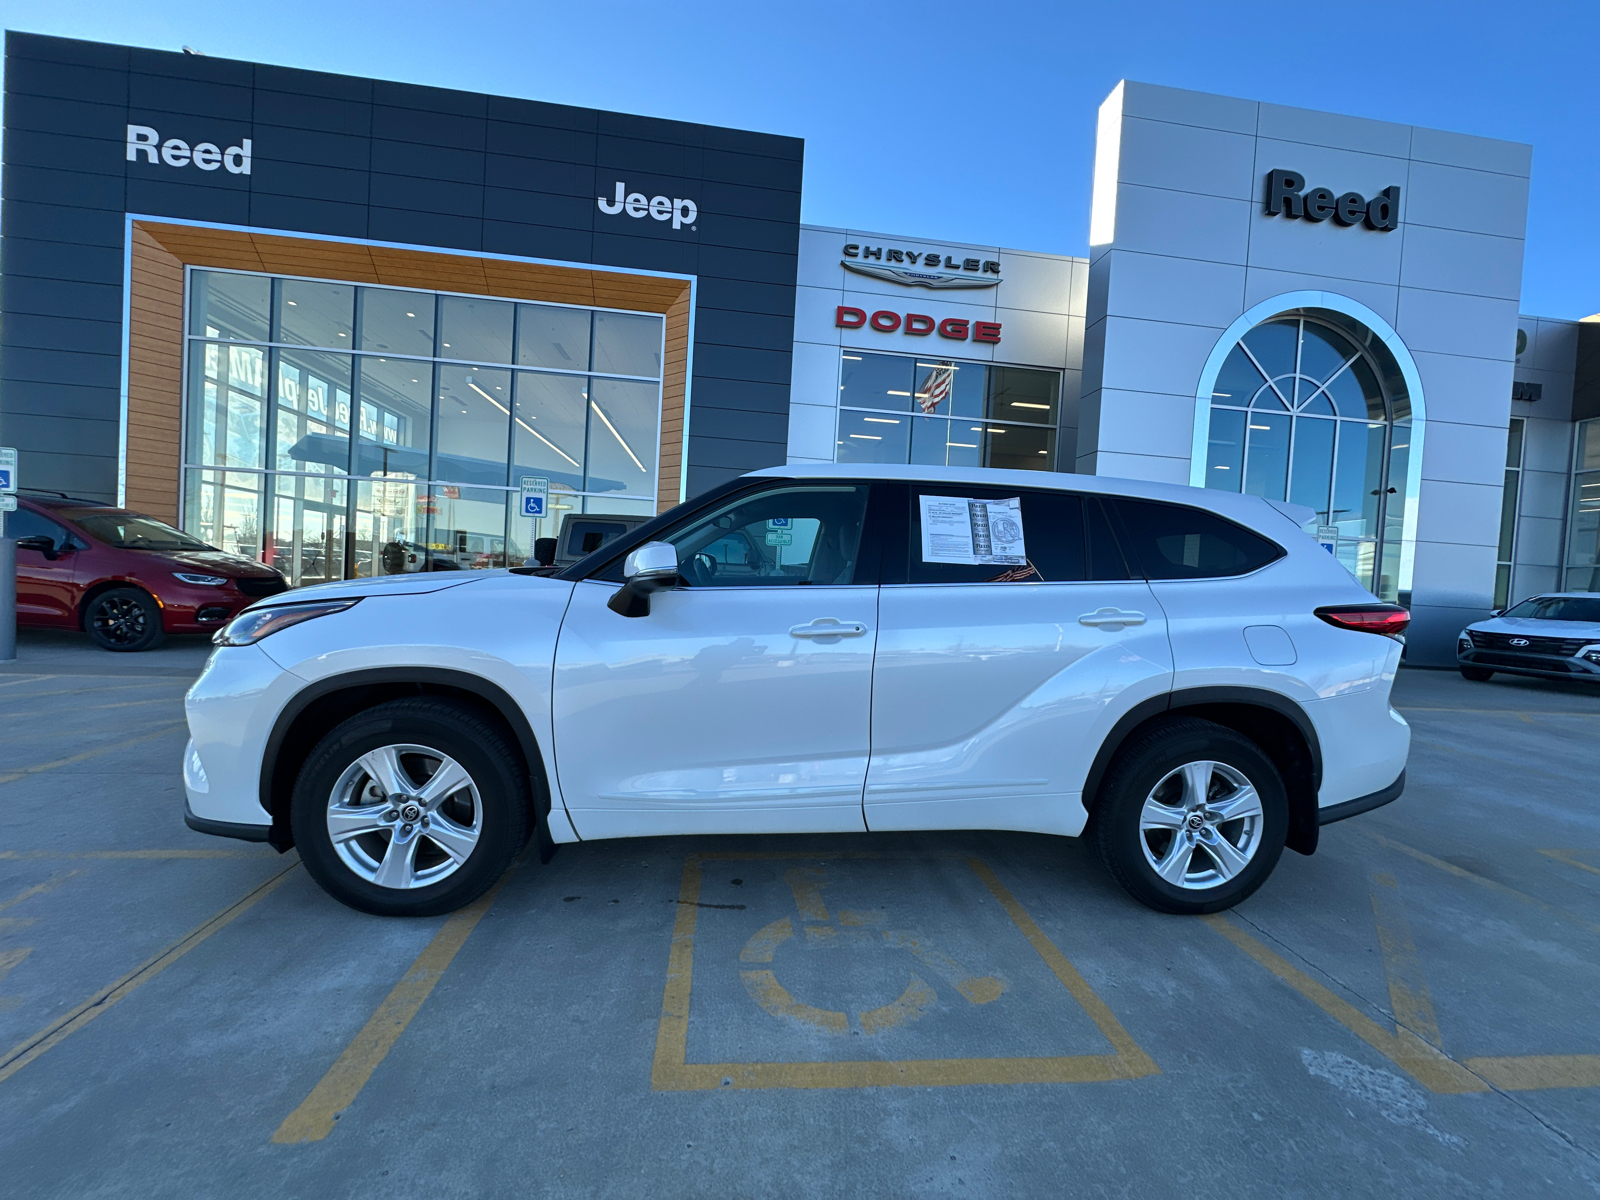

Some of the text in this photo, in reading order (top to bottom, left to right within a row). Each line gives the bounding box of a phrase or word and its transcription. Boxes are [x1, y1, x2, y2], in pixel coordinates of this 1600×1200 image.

[126, 124, 252, 175] Reed
[597, 181, 698, 230] Jeep
[1265, 168, 1401, 232] Reed
[842, 243, 1001, 273] CHRYSLER
[835, 306, 1002, 344] DODGE
